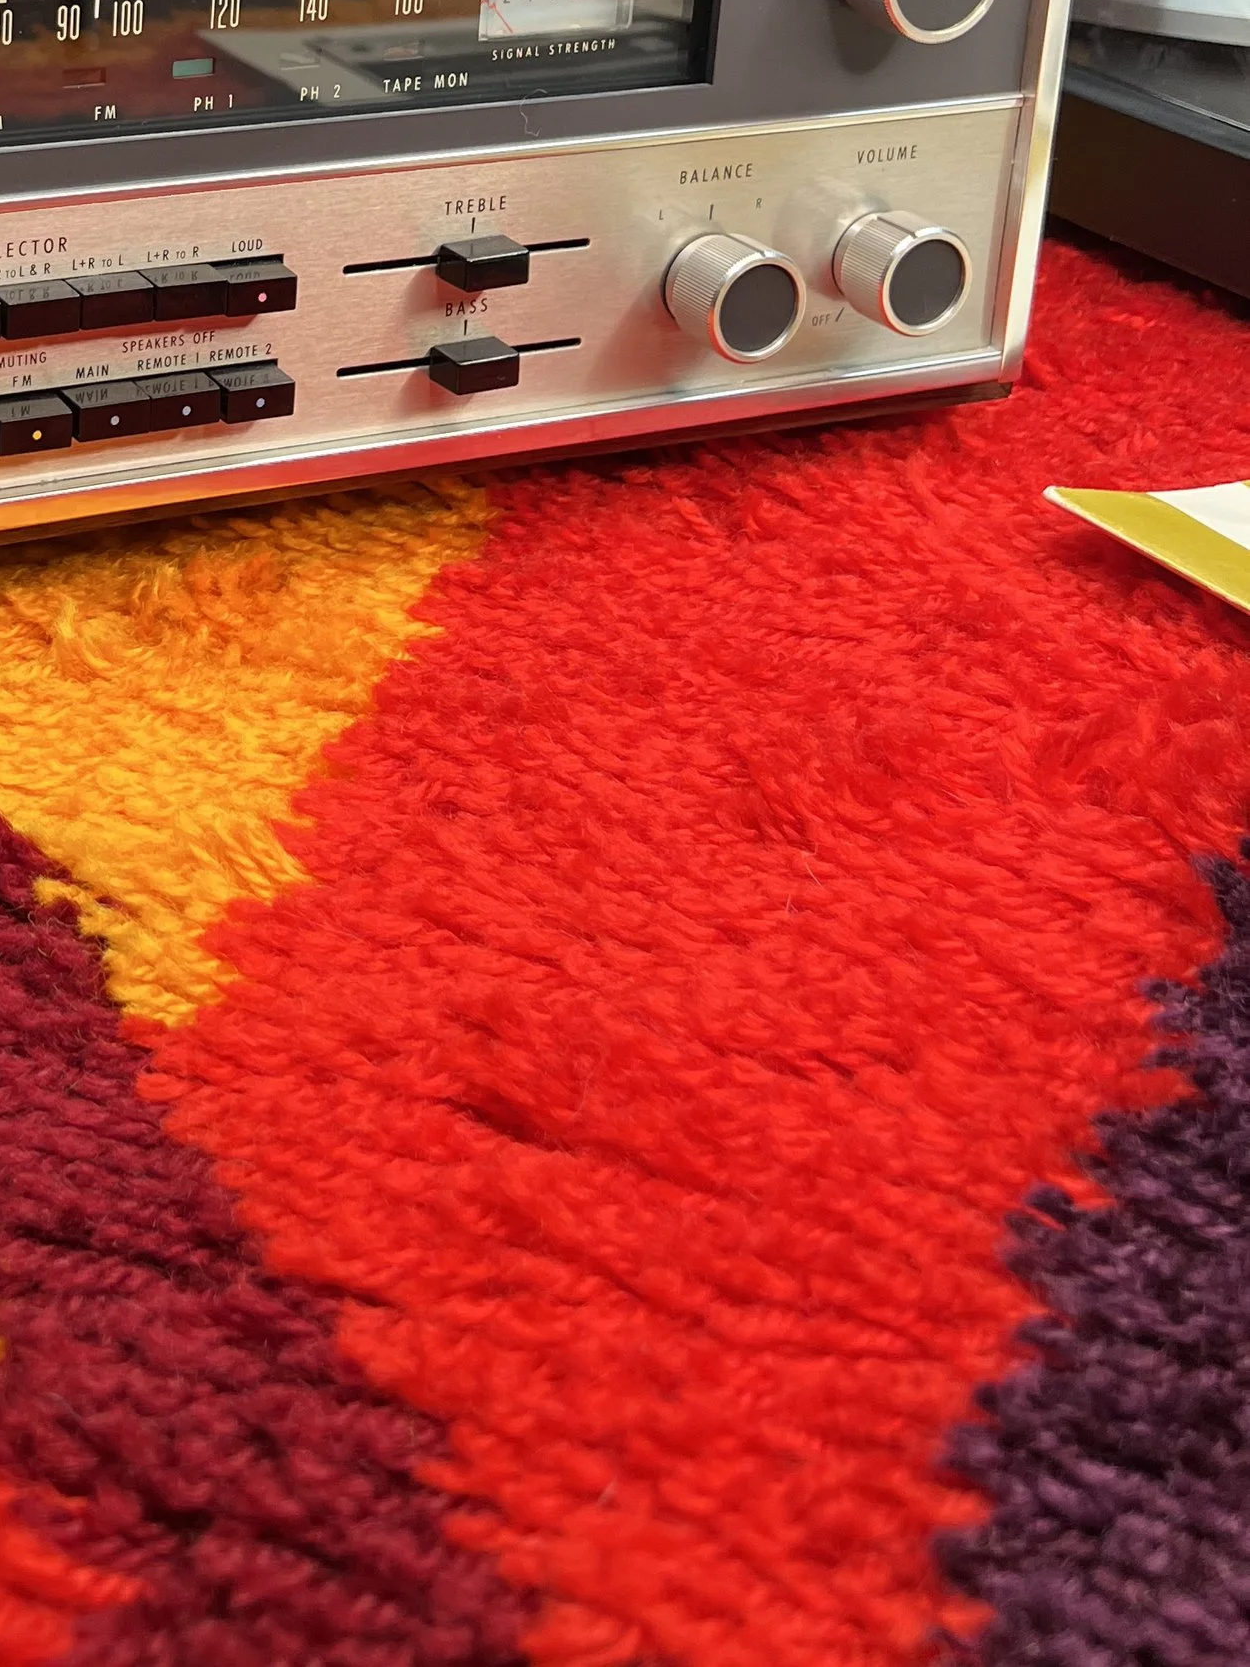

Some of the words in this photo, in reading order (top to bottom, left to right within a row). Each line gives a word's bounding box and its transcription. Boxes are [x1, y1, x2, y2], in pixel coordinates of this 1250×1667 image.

[56, 4, 81, 41] 90
[112, 0, 143, 36] 100
[492, 47, 540, 60] SIGNAL
[549, 39, 616, 56] STRENGTH
[382, 77, 422, 93] TAPE
[434, 72, 468, 88] MON
[300, 86, 320, 101] PH
[331, 84, 341, 99] 2
[193, 96, 214, 112] PH
[228, 94, 234, 109] 1
[94, 105, 117, 121] FM
[857, 145, 918, 164] VOLUME
[680, 163, 753, 184] BALANCE
[445, 196, 506, 215] TREBLE
[658, 209, 664, 220] L
[756, 198, 762, 209] R
[147, 250, 169, 262] L+R
[192, 246, 199, 258] R
[232, 239, 263, 253] LOUD
[30, 264, 37, 275] &
[44, 263, 51, 274] R
[72, 257, 95, 271] L+R
[118, 255, 124, 266] L
[445, 298, 488, 317] BASS
[812, 313, 830, 327] OFF
[122, 335, 185, 354] SPEAKERS
[193, 331, 215, 344] OFF
[209, 345, 258, 362] REMOTE
[265, 343, 272, 355] 2
[137, 354, 186, 371] REMOTE
[12, 374, 32, 387] FM
[75, 365, 110, 379] MAIN
